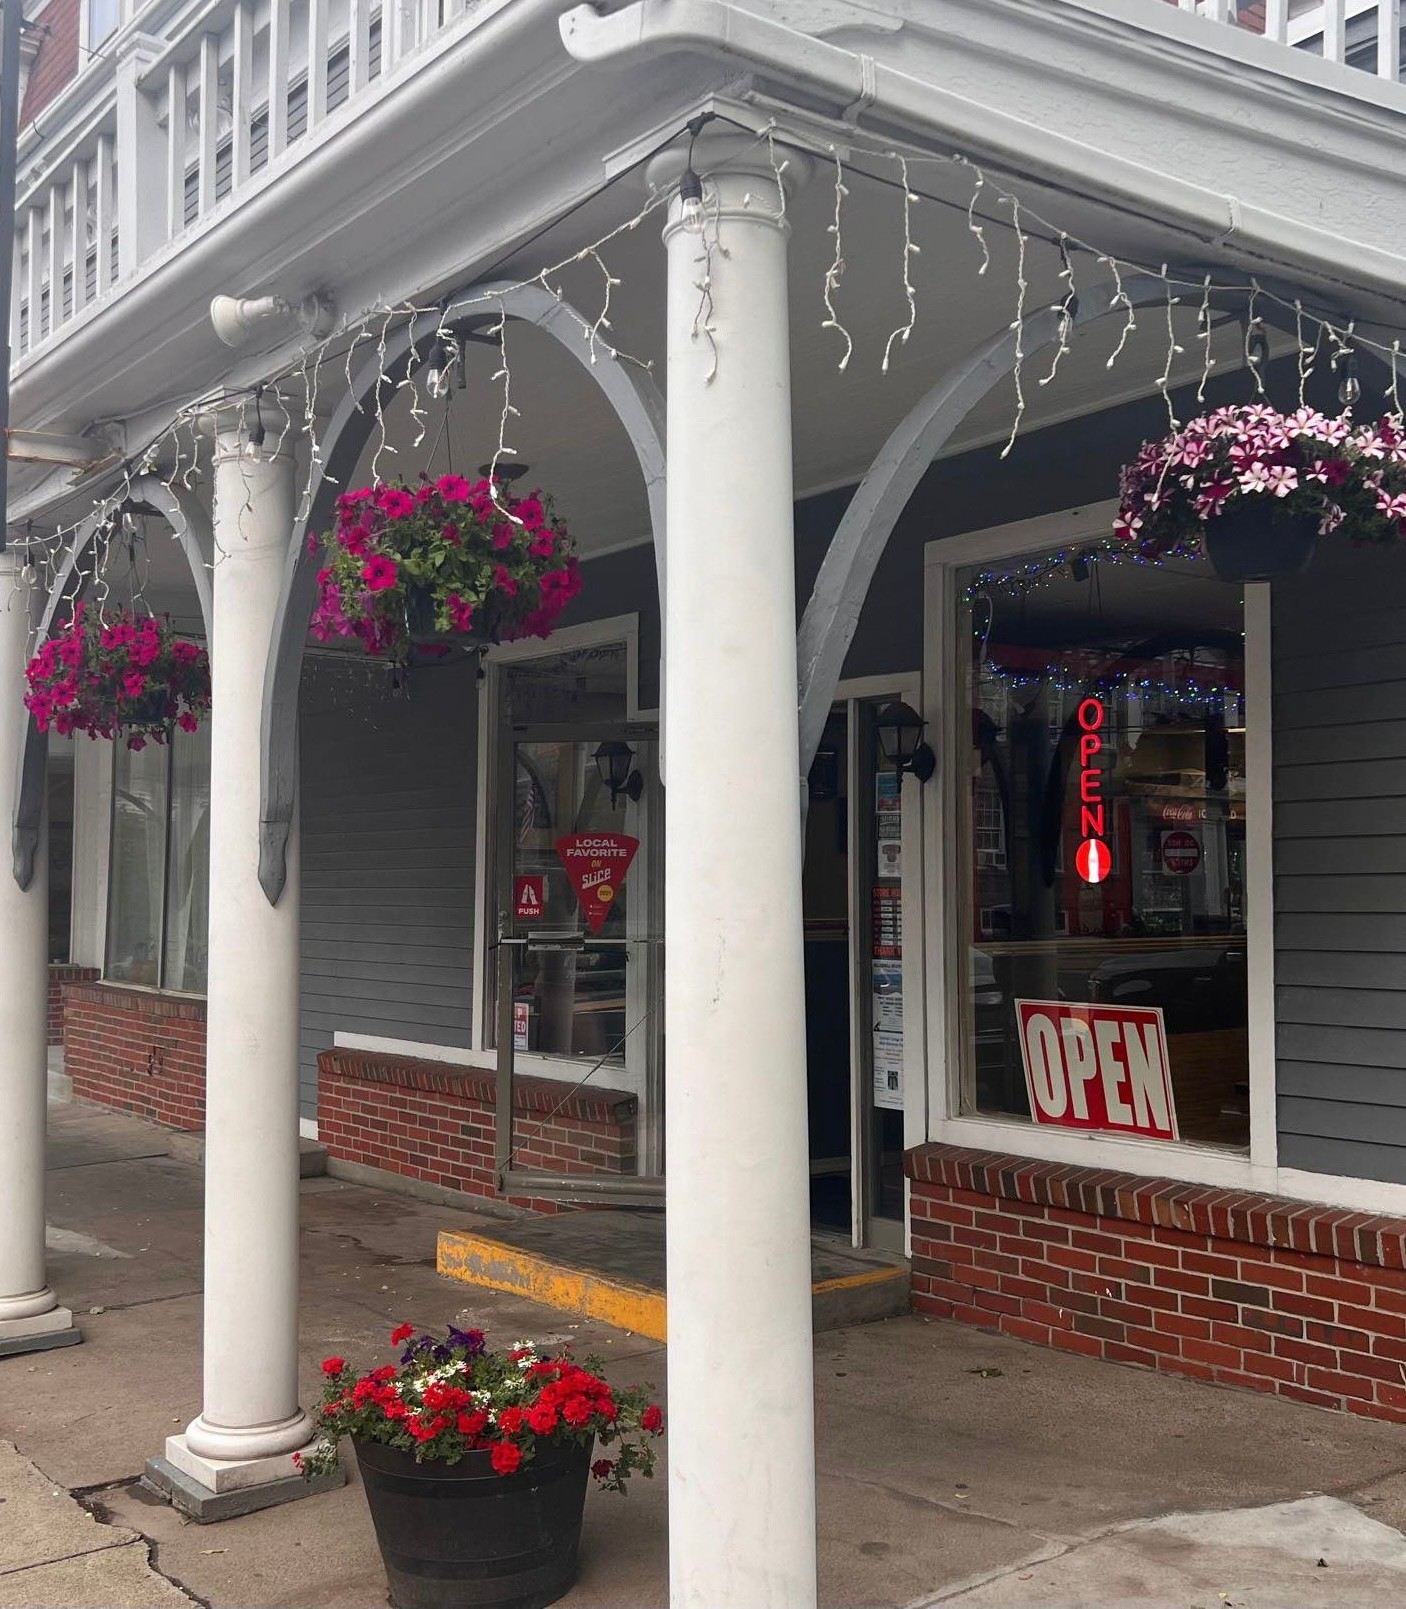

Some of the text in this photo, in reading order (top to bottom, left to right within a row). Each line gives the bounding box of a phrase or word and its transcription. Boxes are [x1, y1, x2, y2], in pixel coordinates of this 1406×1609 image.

[1078, 698, 1105, 837] OPEN
[575, 839, 618, 847] LOCAL
[566, 848, 627, 857] FAVORITE
[591, 860, 602, 868] ON
[1026, 1012, 1170, 1131] OPEN
